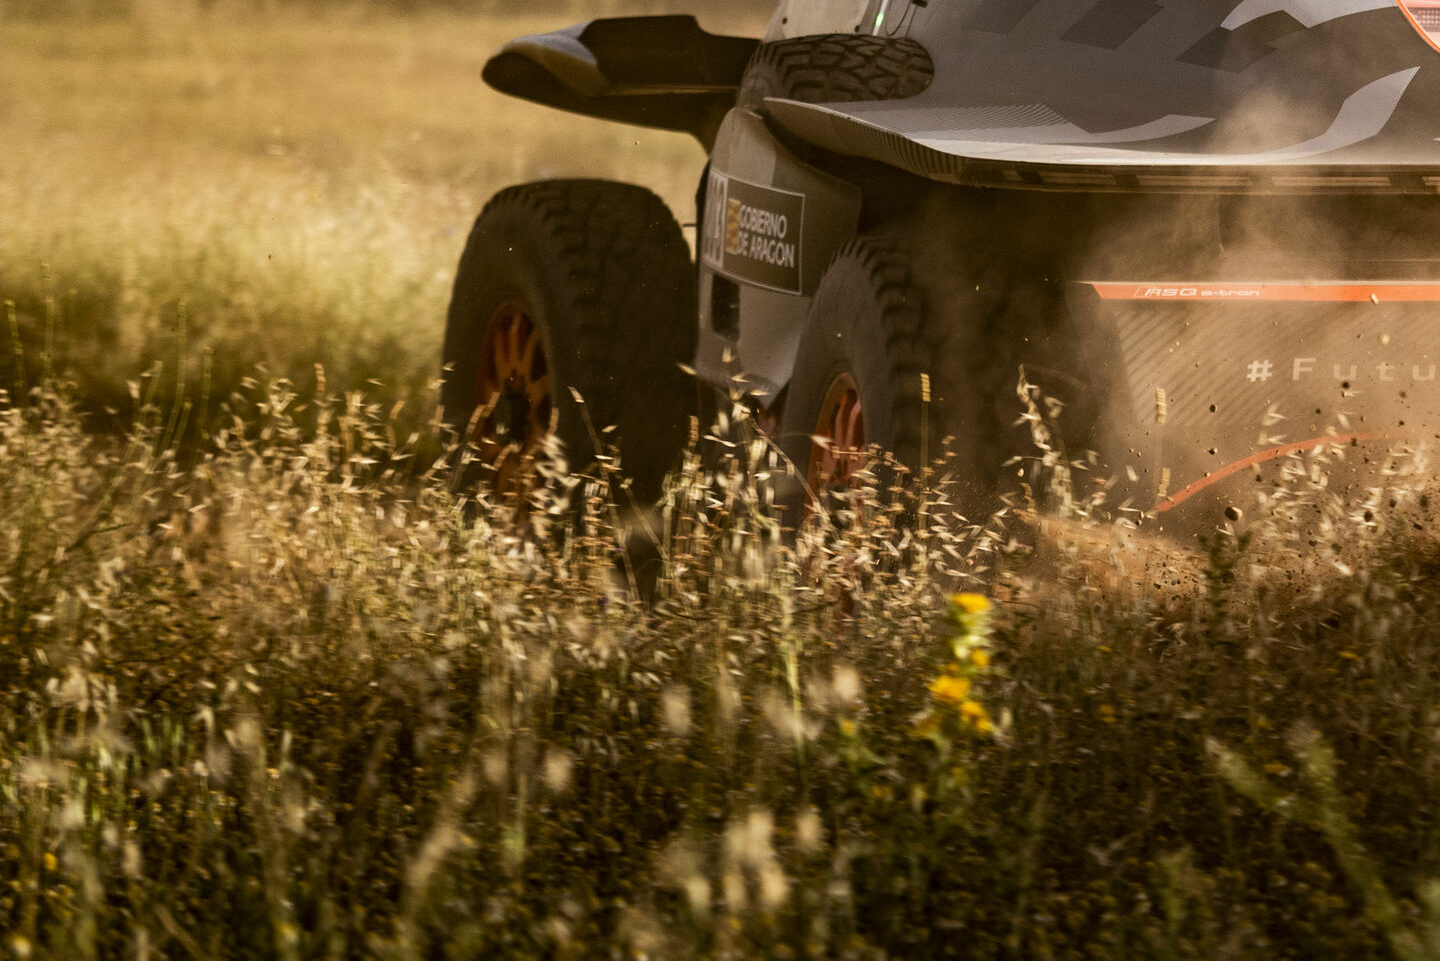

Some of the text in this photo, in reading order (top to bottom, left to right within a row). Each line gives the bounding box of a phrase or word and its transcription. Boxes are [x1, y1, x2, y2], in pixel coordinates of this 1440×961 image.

[740, 205, 787, 239] GOBIERNO
[737, 230, 795, 269] DE ARAGON
